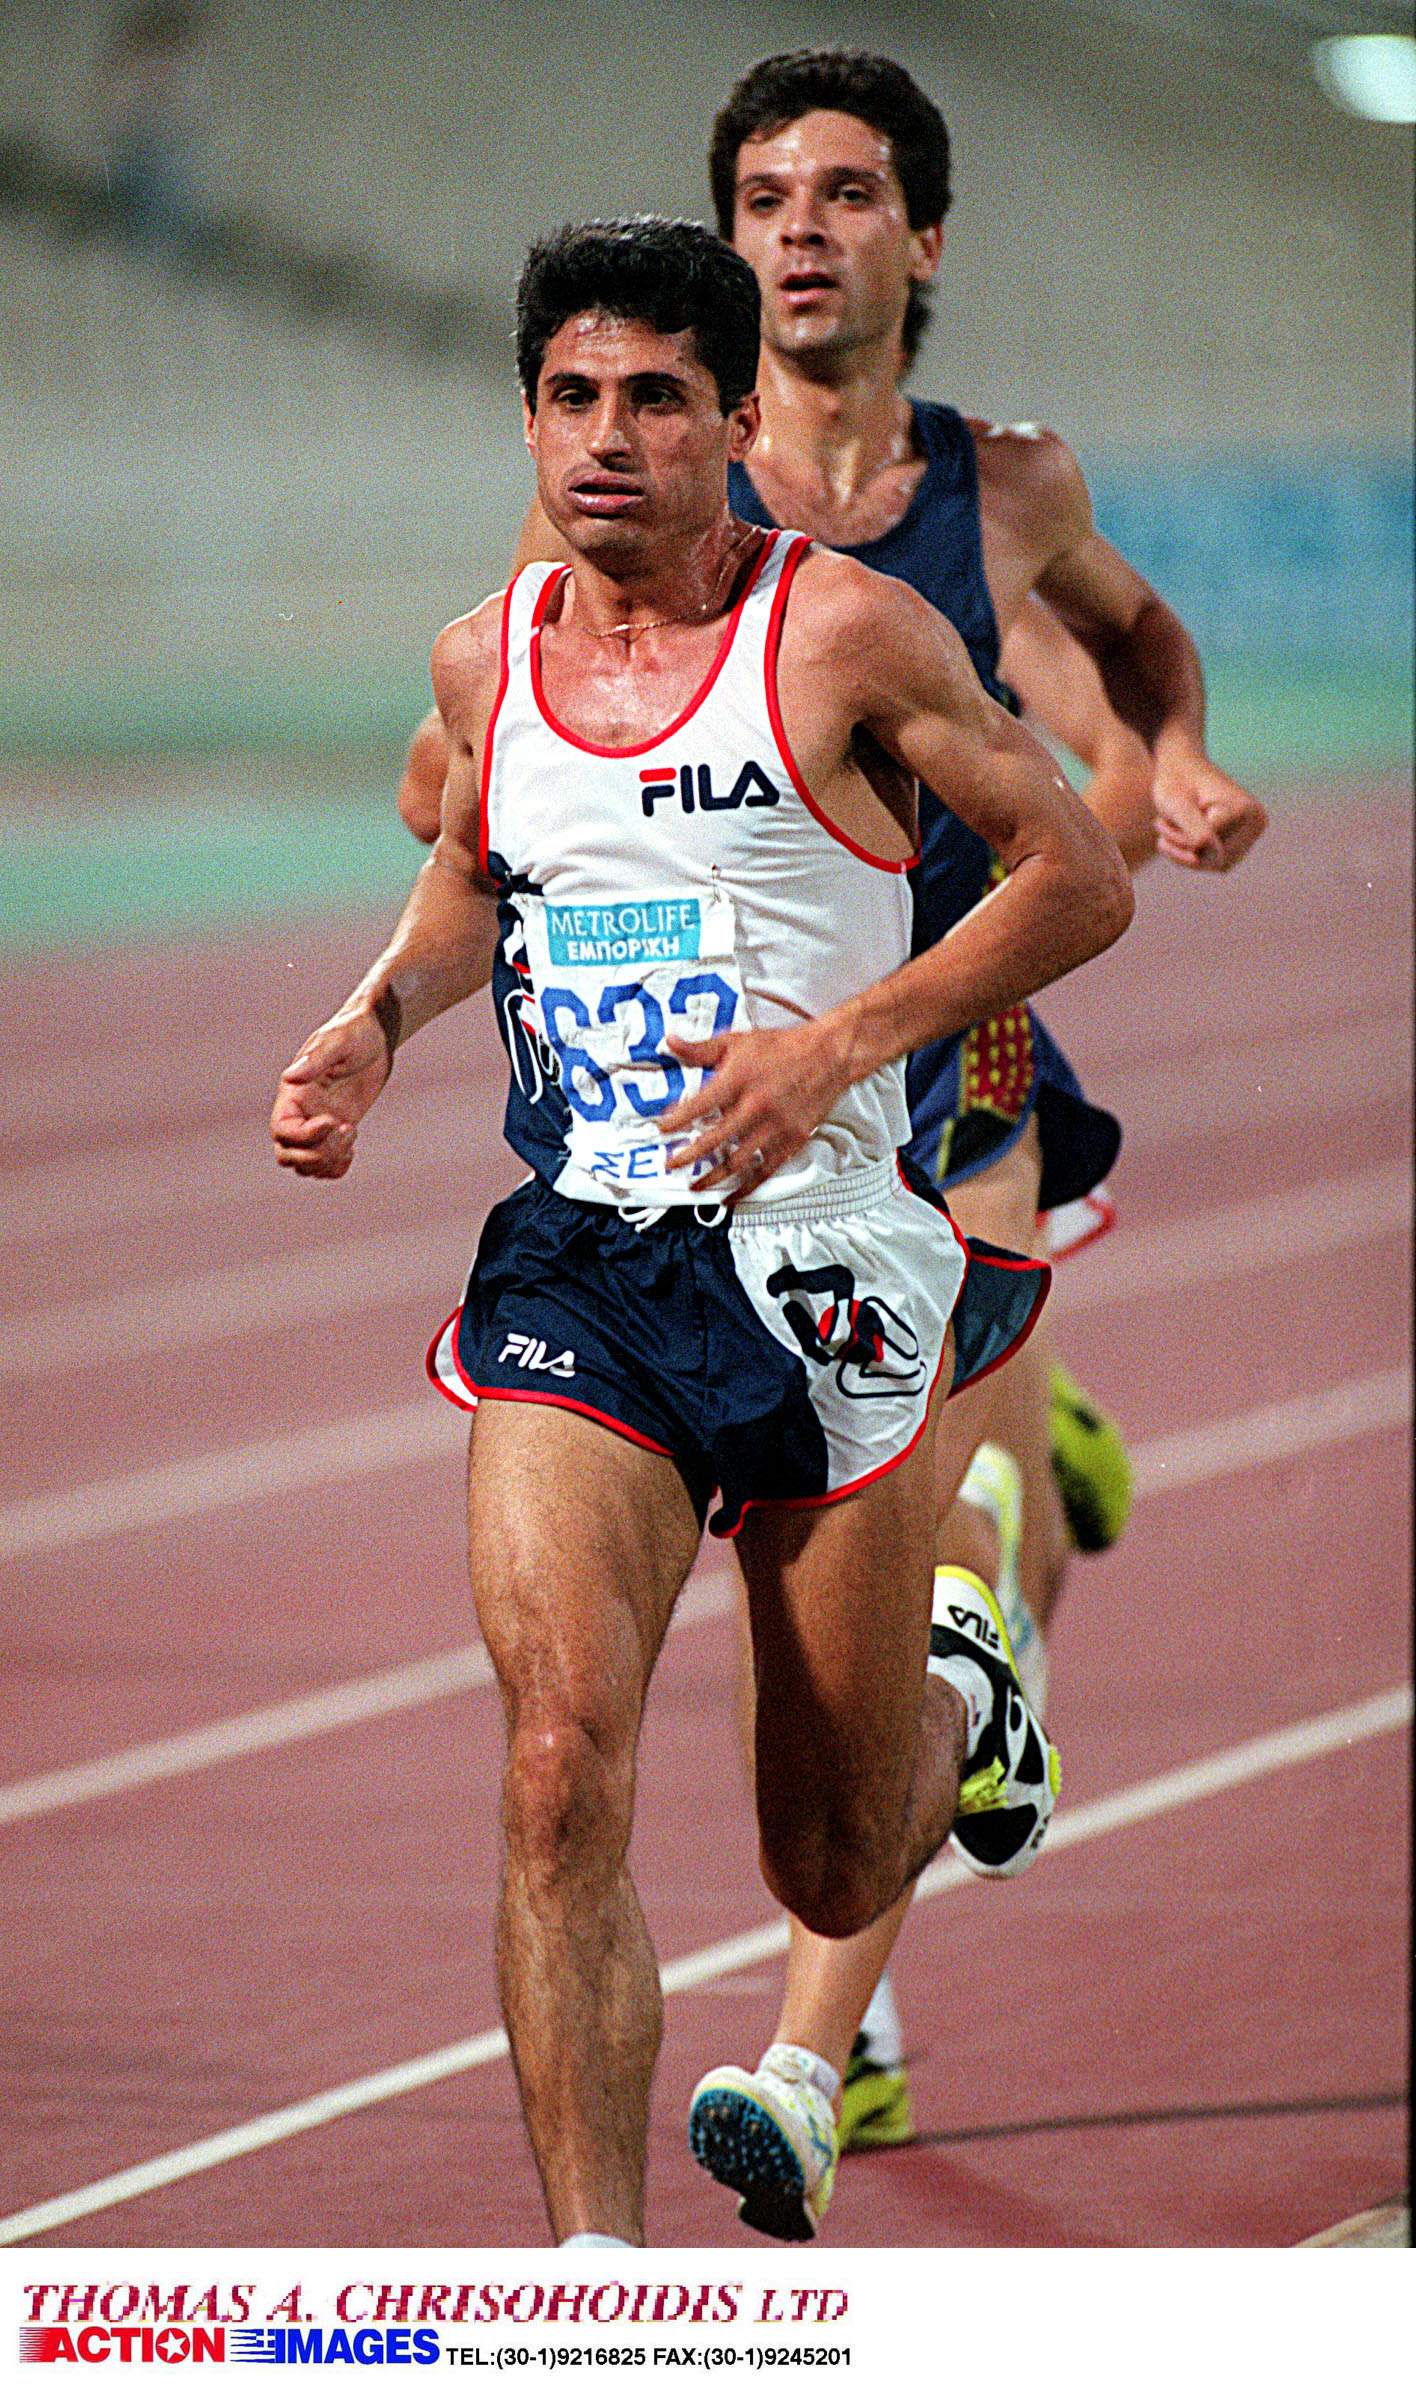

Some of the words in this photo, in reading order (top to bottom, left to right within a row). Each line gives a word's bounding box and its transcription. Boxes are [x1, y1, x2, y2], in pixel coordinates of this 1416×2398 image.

[639, 761, 780, 817] FILA
[551, 904, 695, 936] METROLIFE
[498, 1333, 576, 1379] FILA
[947, 1604, 999, 1650] FILA
